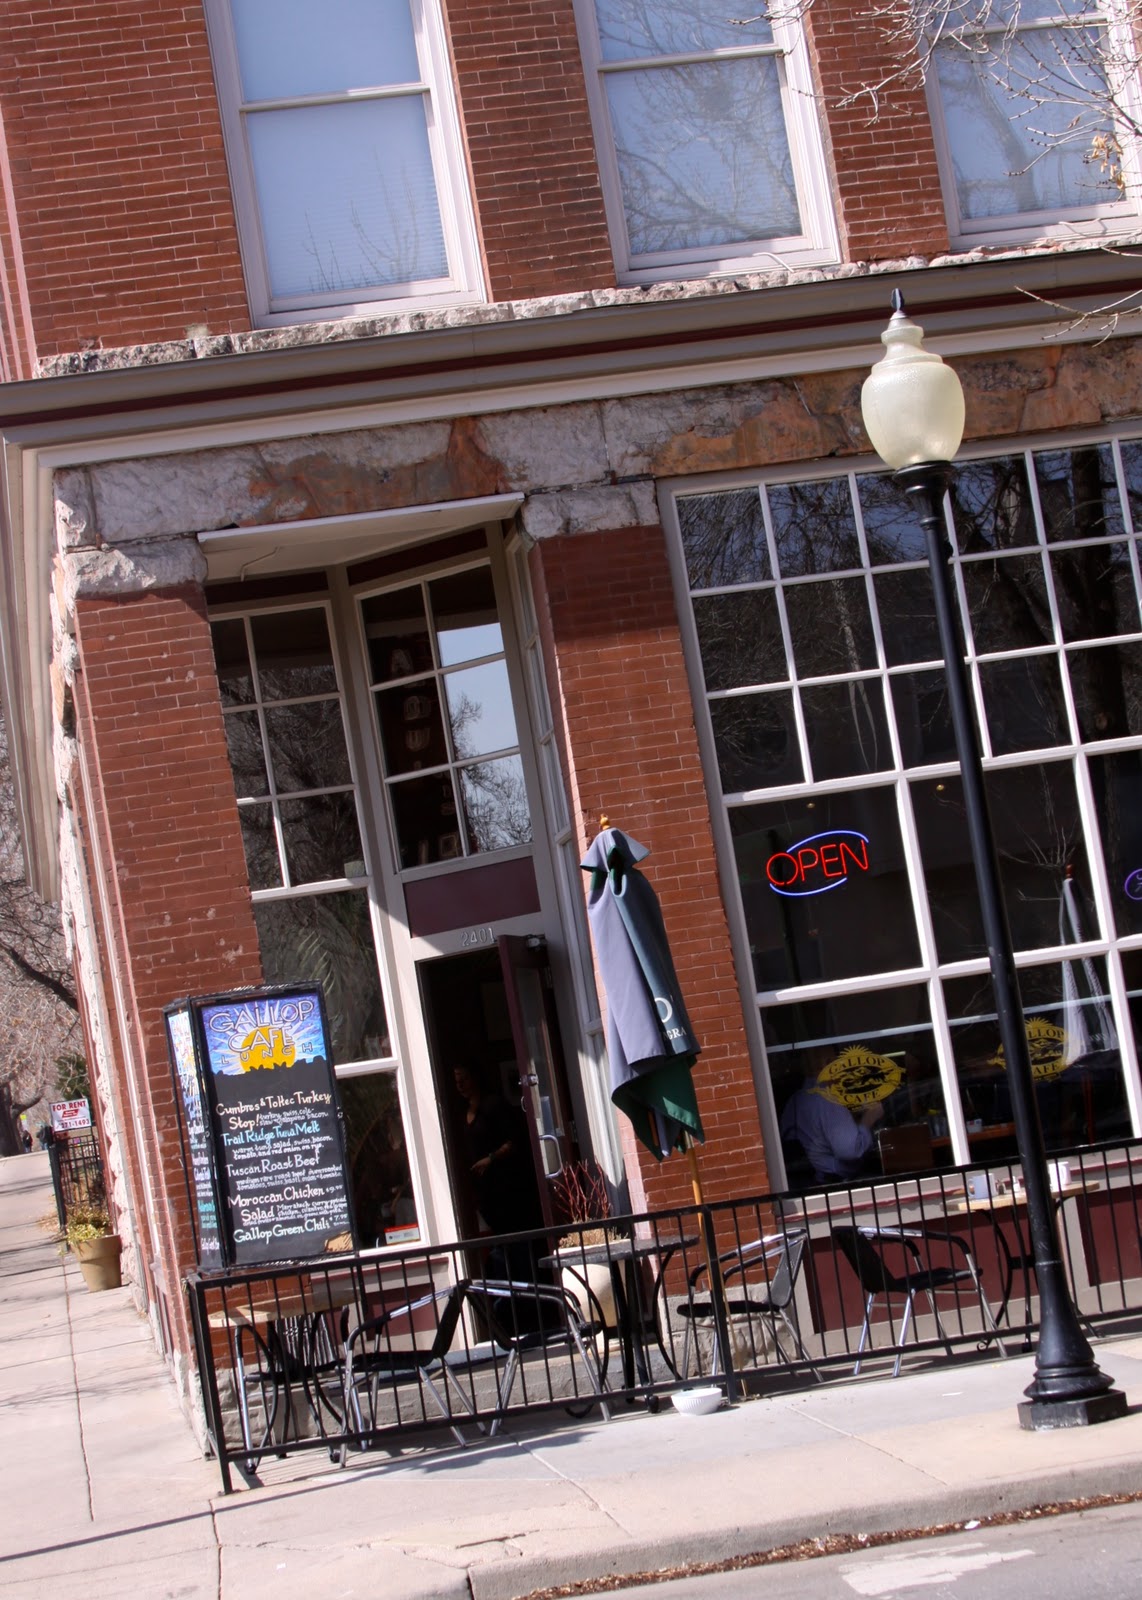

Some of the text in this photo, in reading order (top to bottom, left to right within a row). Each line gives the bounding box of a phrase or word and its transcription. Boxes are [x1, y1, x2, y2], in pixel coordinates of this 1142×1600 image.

[766, 839, 869, 886] OPEN
[461, 927, 495, 947] 2401
[209, 1000, 315, 1033] GALLOP
[228, 1025, 295, 1053] CAFE
[1027, 1028, 1064, 1039] LLOP
[221, 1042, 314, 1065] LUNCH
[828, 1056, 886, 1075] GALLOP
[1033, 1062, 1059, 1075] AFE
[52, 1100, 86, 1112] FOR RENT
[216, 1102, 260, 1115] Cumbres
[294, 1090, 332, 1104] Turkey
[843, 1089, 881, 1104] CAFE
[220, 1121, 321, 1147] Trail Ridge Tuna Melt
[228, 1114, 260, 1131] Stop!
[226, 1162, 261, 1177] Tuscan
[261, 1157, 294, 1173] Roast
[294, 1152, 320, 1168] Beef
[228, 1192, 284, 1209] Moroccan
[283, 1183, 326, 1201] Chicken
[240, 1205, 275, 1222] Salad
[233, 1216, 330, 1244] Gallop Green Chili
